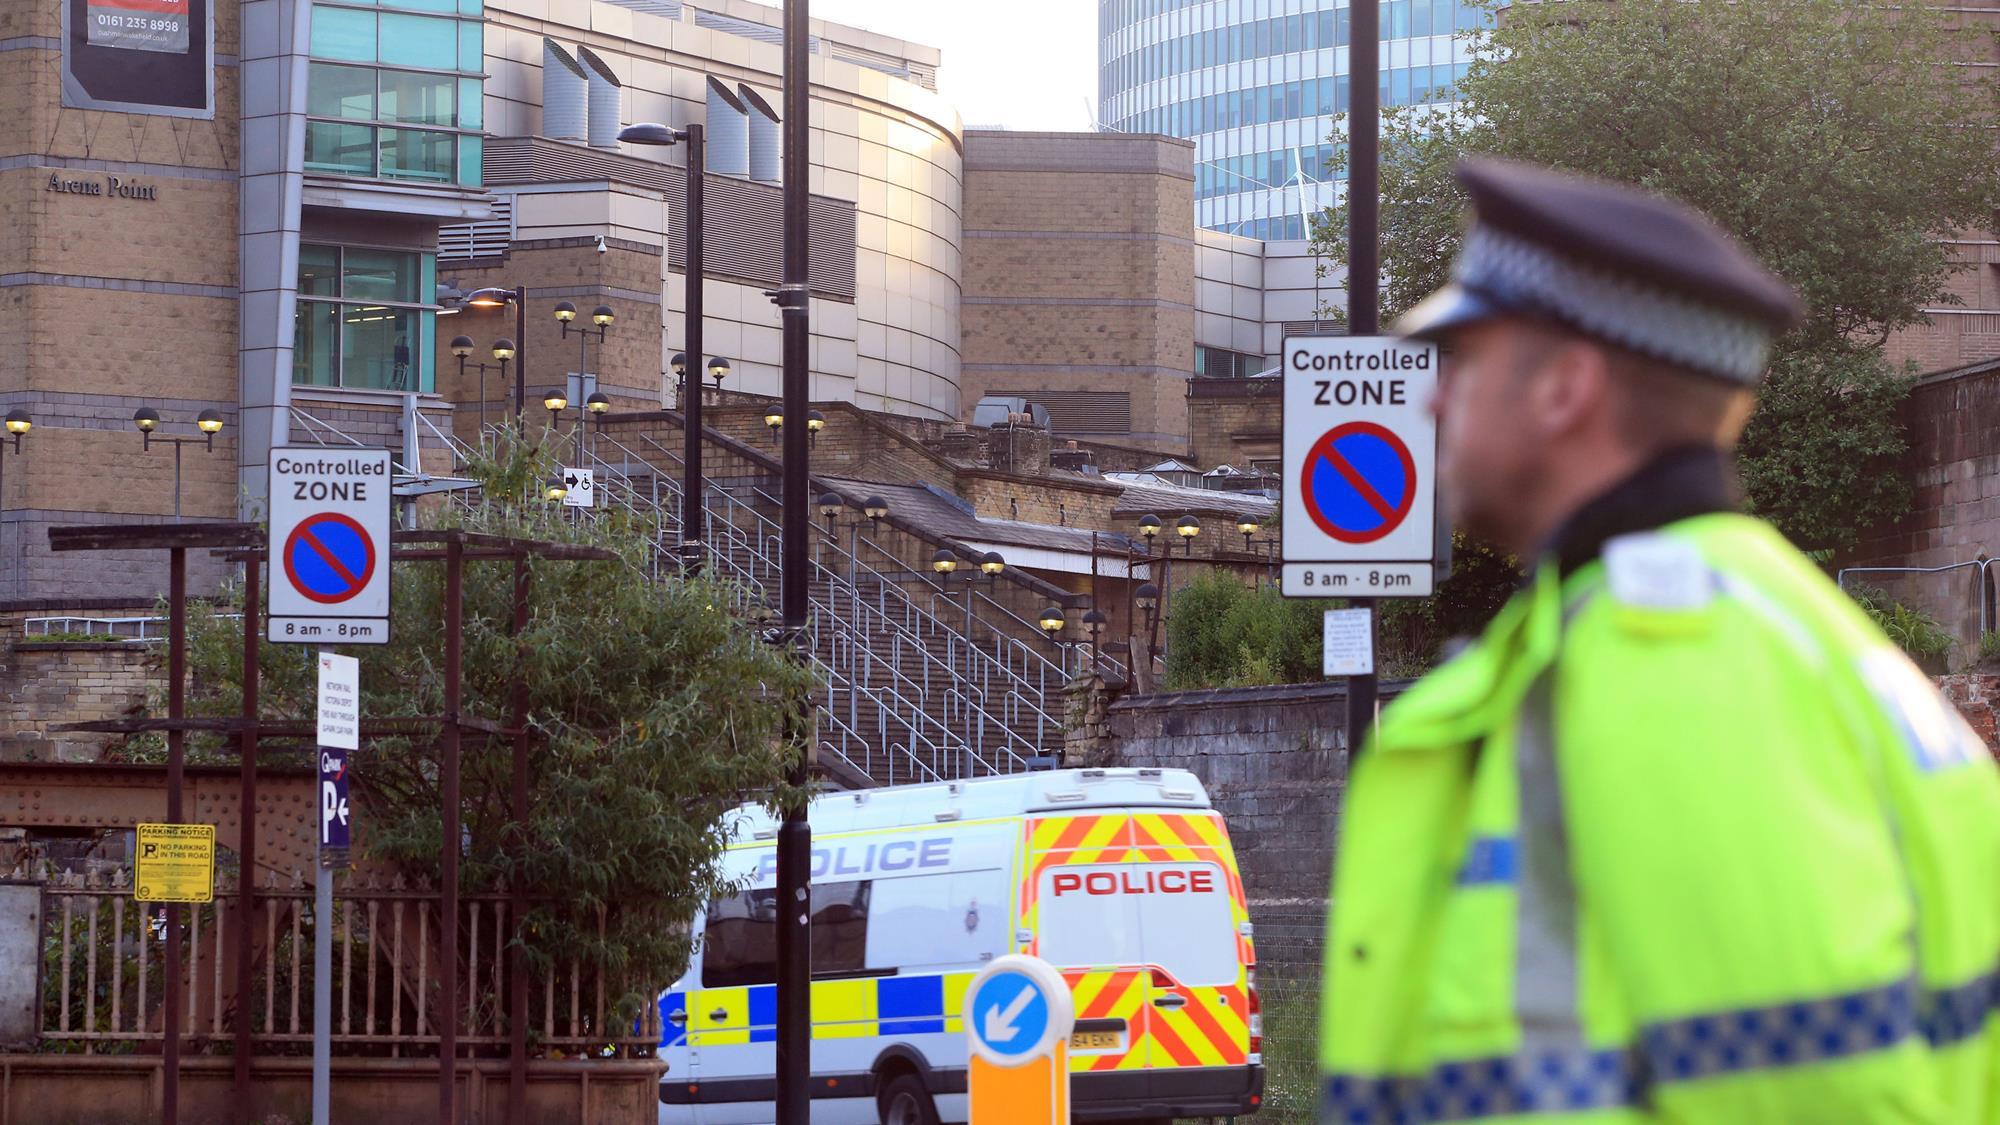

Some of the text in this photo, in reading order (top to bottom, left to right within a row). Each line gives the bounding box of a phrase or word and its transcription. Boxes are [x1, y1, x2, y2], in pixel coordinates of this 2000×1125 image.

[98, 14, 179, 32] 0161 235 8998
[46, 172, 157, 200] Arena Point
[1292, 348, 1430, 371] Controlled
[1314, 380, 1406, 405] ZONE
[276, 458, 385, 475] Controlled
[294, 481, 367, 501] ZONE
[1303, 570, 1314, 586] 8
[1321, 574, 1348, 586] am
[286, 623, 294, 635] 8
[300, 625, 321, 635] am
[323, 780, 338, 843] P
[1053, 870, 1214, 897] POLICE
